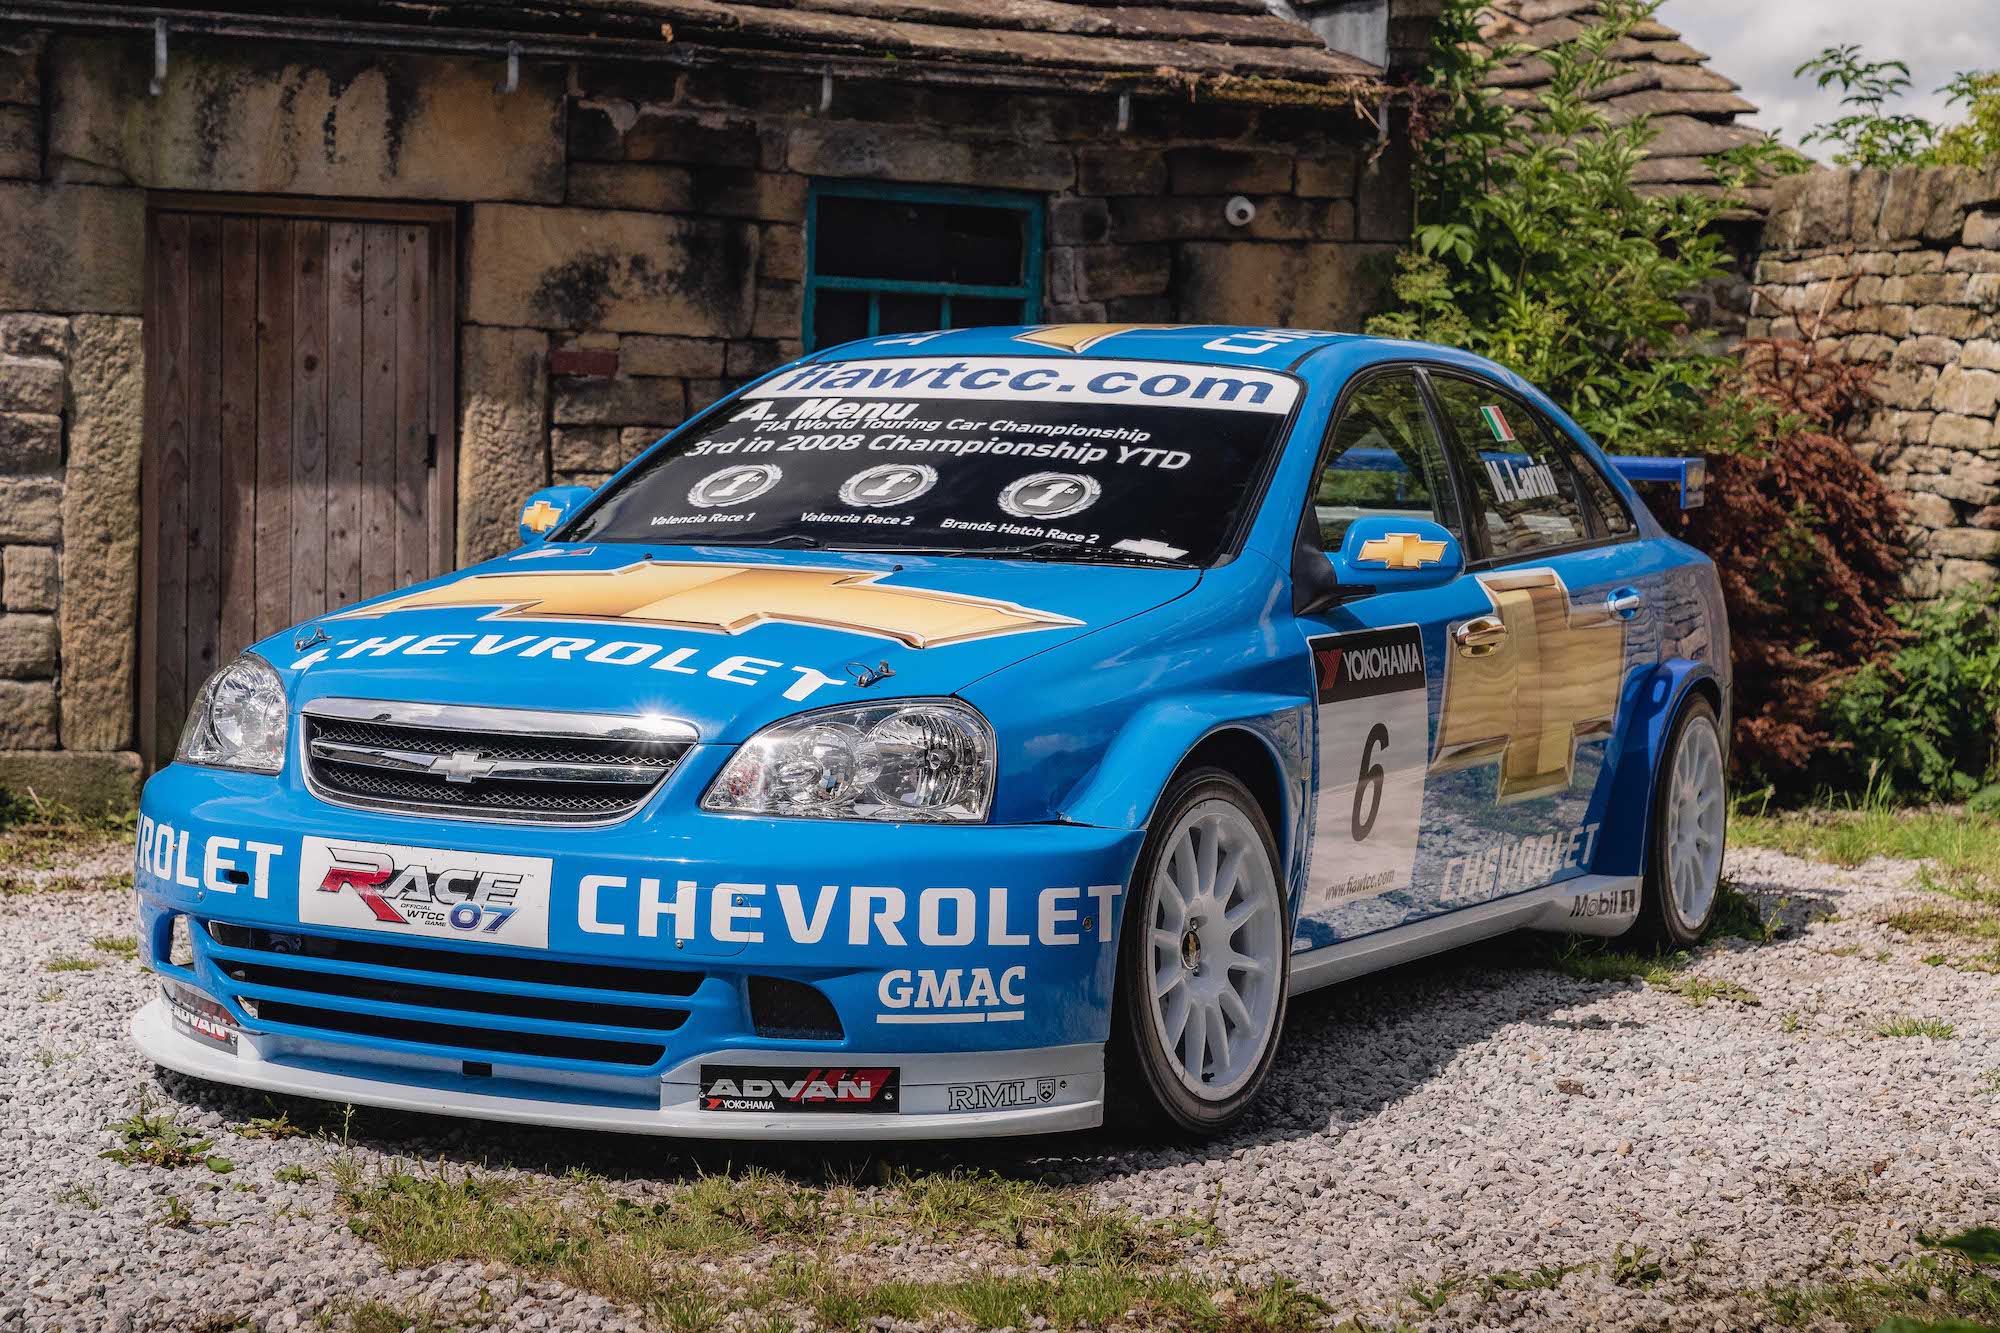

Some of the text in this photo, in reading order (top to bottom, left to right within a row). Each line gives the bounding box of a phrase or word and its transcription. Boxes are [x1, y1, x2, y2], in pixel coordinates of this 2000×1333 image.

[776, 363, 1275, 404] fiawtcc.com
[728, 398, 919, 423] A. Menu
[754, 418, 1150, 443] FIA World Touring Car Championship
[685, 435, 1191, 470] 3rd in 2008 Championship YTD
[1485, 455, 1559, 503] N. Larini
[651, 513, 756, 525] Valencia Race 1
[800, 513, 915, 526] Valencia Race 2
[940, 518, 1100, 544] Brands Hatch Race 2
[290, 635, 847, 702] CHEVROLET
[1342, 643, 1422, 682] YOKOHAMA
[1351, 722, 1389, 842] 6
[1440, 822, 1600, 902] CHEVROLET
[316, 847, 524, 925] RACE
[1325, 869, 1395, 901] www.fiawtcc.com
[400, 903, 431, 911] OFFICIAL
[406, 909, 445, 921] WTCC
[449, 902, 519, 934] 07
[577, 874, 1122, 946] CHEVROLET
[1569, 891, 1618, 917] Mobil
[877, 965, 1026, 1009] GMAC
[706, 1078, 871, 1099] ADVAN
[722, 1099, 775, 1110] YOKOHAMA
[948, 1081, 1037, 1111] RML
